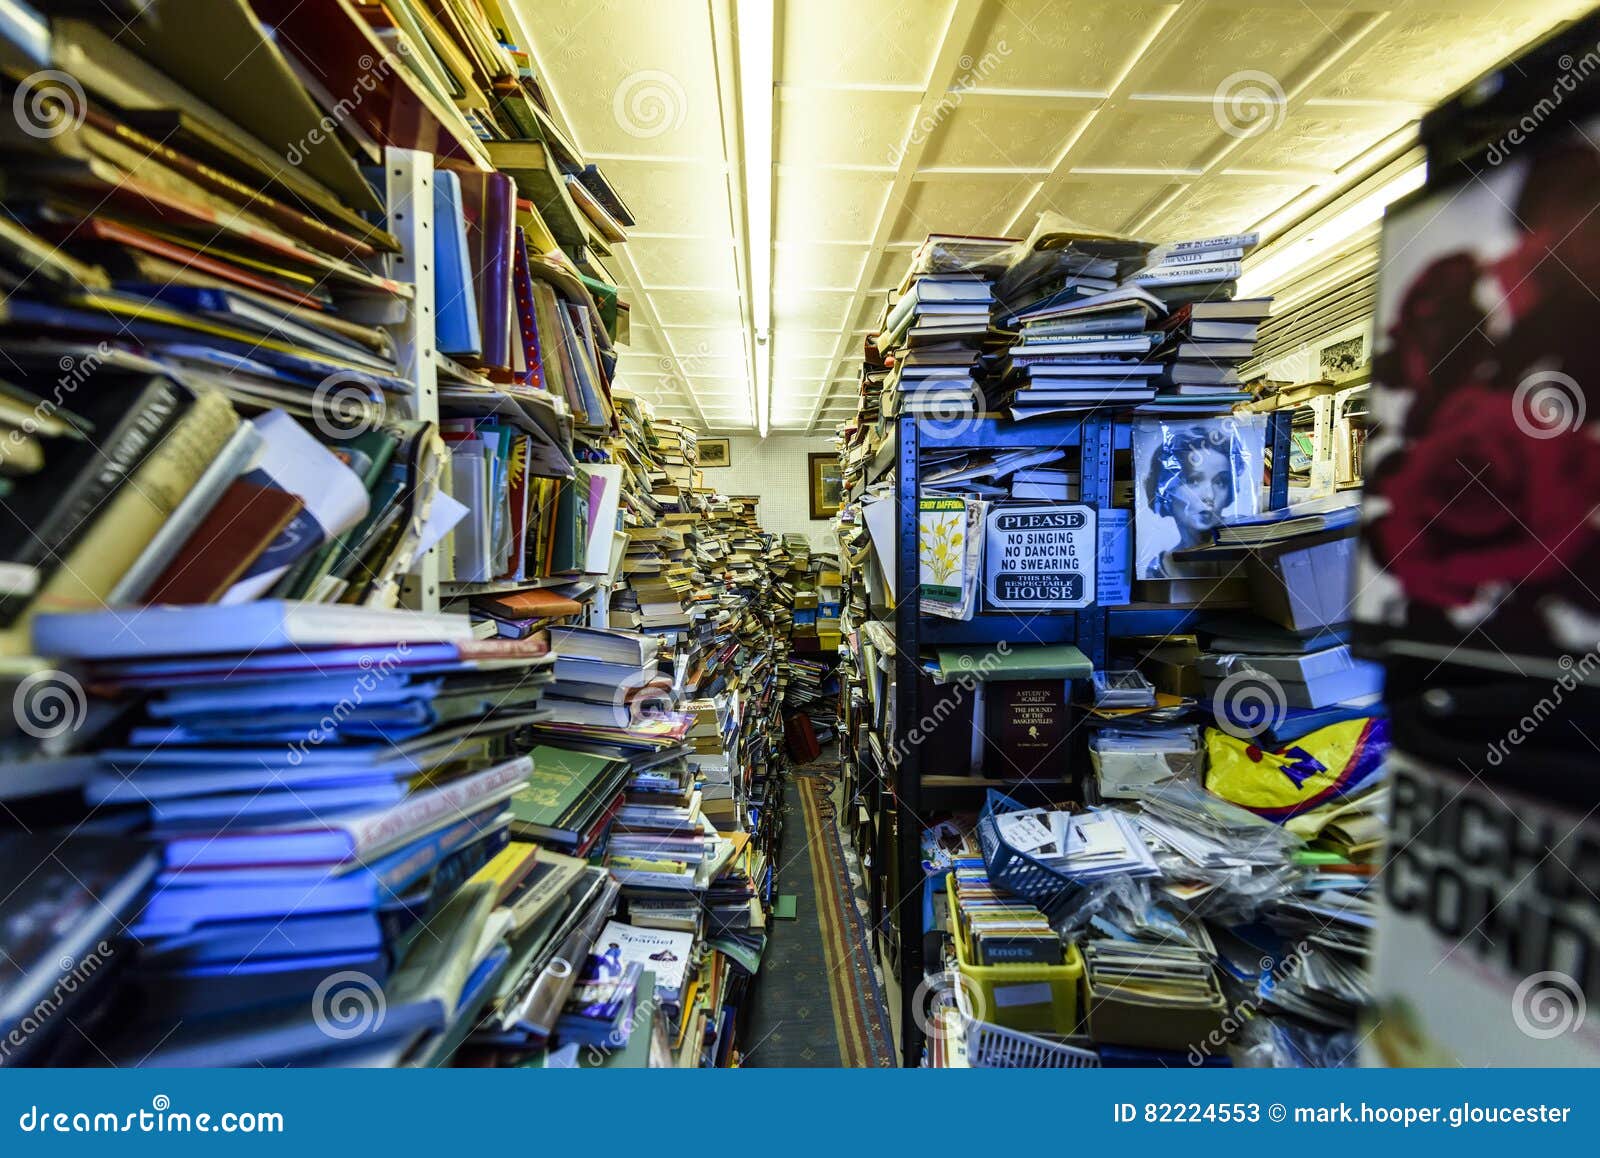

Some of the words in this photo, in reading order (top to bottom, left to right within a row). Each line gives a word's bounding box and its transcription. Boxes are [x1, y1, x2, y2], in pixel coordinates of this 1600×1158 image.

[1005, 514, 1080, 528] PLEASE
[1008, 534, 1023, 544] NO
[1027, 532, 1073, 544] SINGING
[1005, 546, 1020, 557] NO
[1025, 545, 1076, 557] DANCING
[1001, 559, 1016, 570] NO
[1021, 558, 1079, 570] SWEARING
[1005, 586, 1073, 599] HOUSE
[987, 947, 1033, 957] Knots
